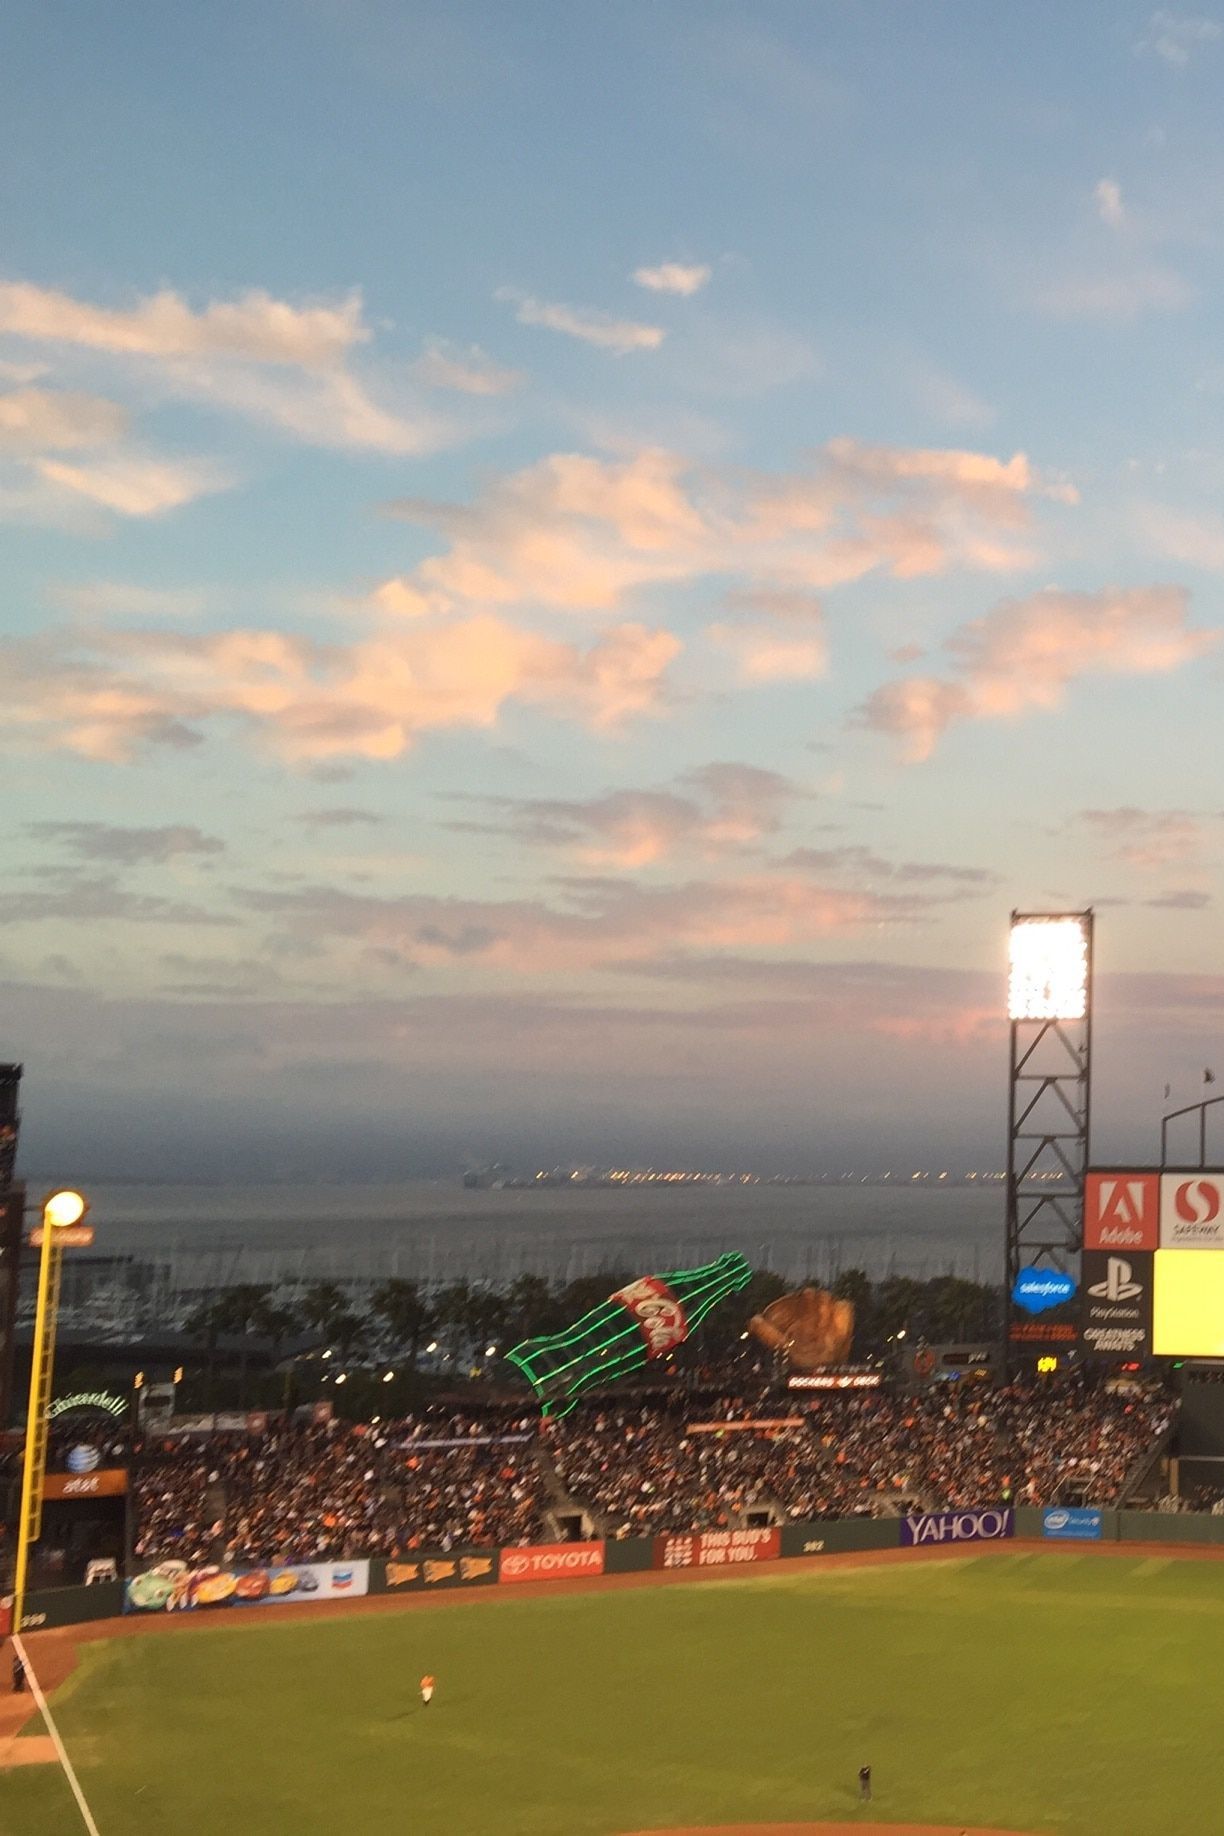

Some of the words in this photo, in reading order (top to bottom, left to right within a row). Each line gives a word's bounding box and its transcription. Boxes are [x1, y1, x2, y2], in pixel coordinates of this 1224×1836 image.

[906, 1509, 1010, 1545] YAHOO!
[530, 1550, 602, 1571] TOYOTA
[700, 1547, 727, 1565] FOR
